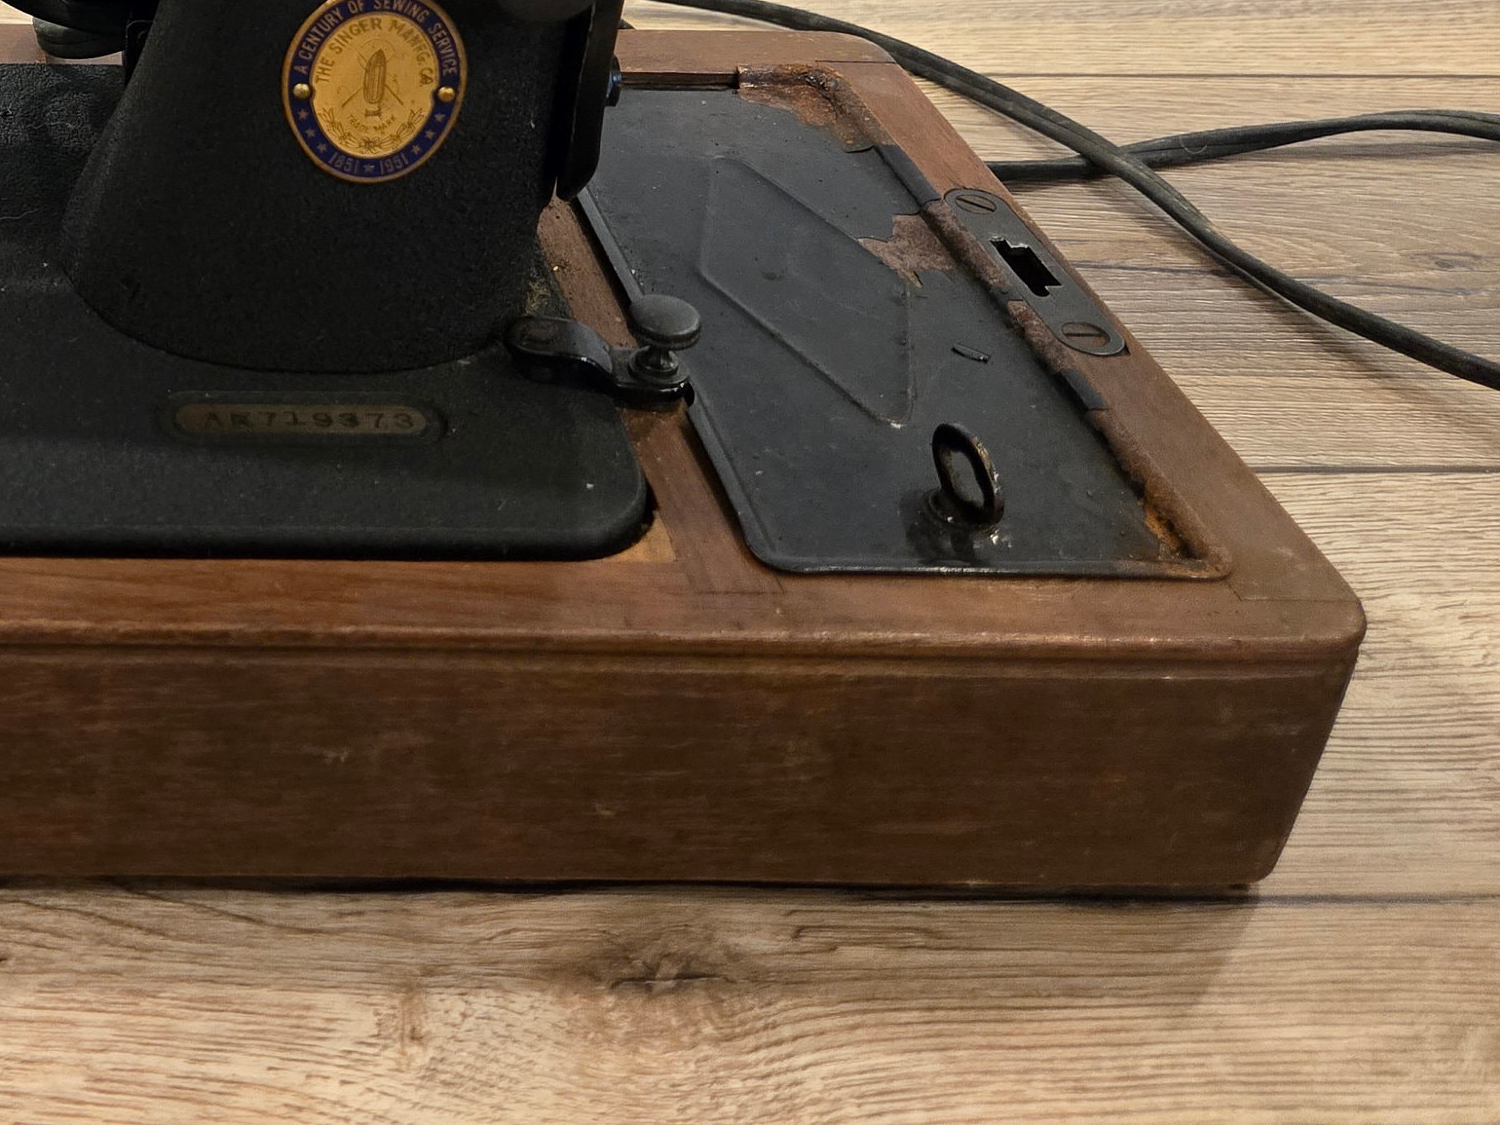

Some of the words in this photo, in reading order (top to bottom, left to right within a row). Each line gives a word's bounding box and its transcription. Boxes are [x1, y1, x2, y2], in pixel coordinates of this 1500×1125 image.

[297, 8, 344, 60] CENTURY
[315, 55, 336, 84] THE
[329, 17, 383, 55] SINGER
[427, 22, 458, 76] SERVICE
[293, 64, 309, 75] A
[348, 114, 369, 133] TRADE
[374, 114, 397, 134] MARK
[328, 154, 359, 175] 1851
[380, 152, 410, 175] 1951
